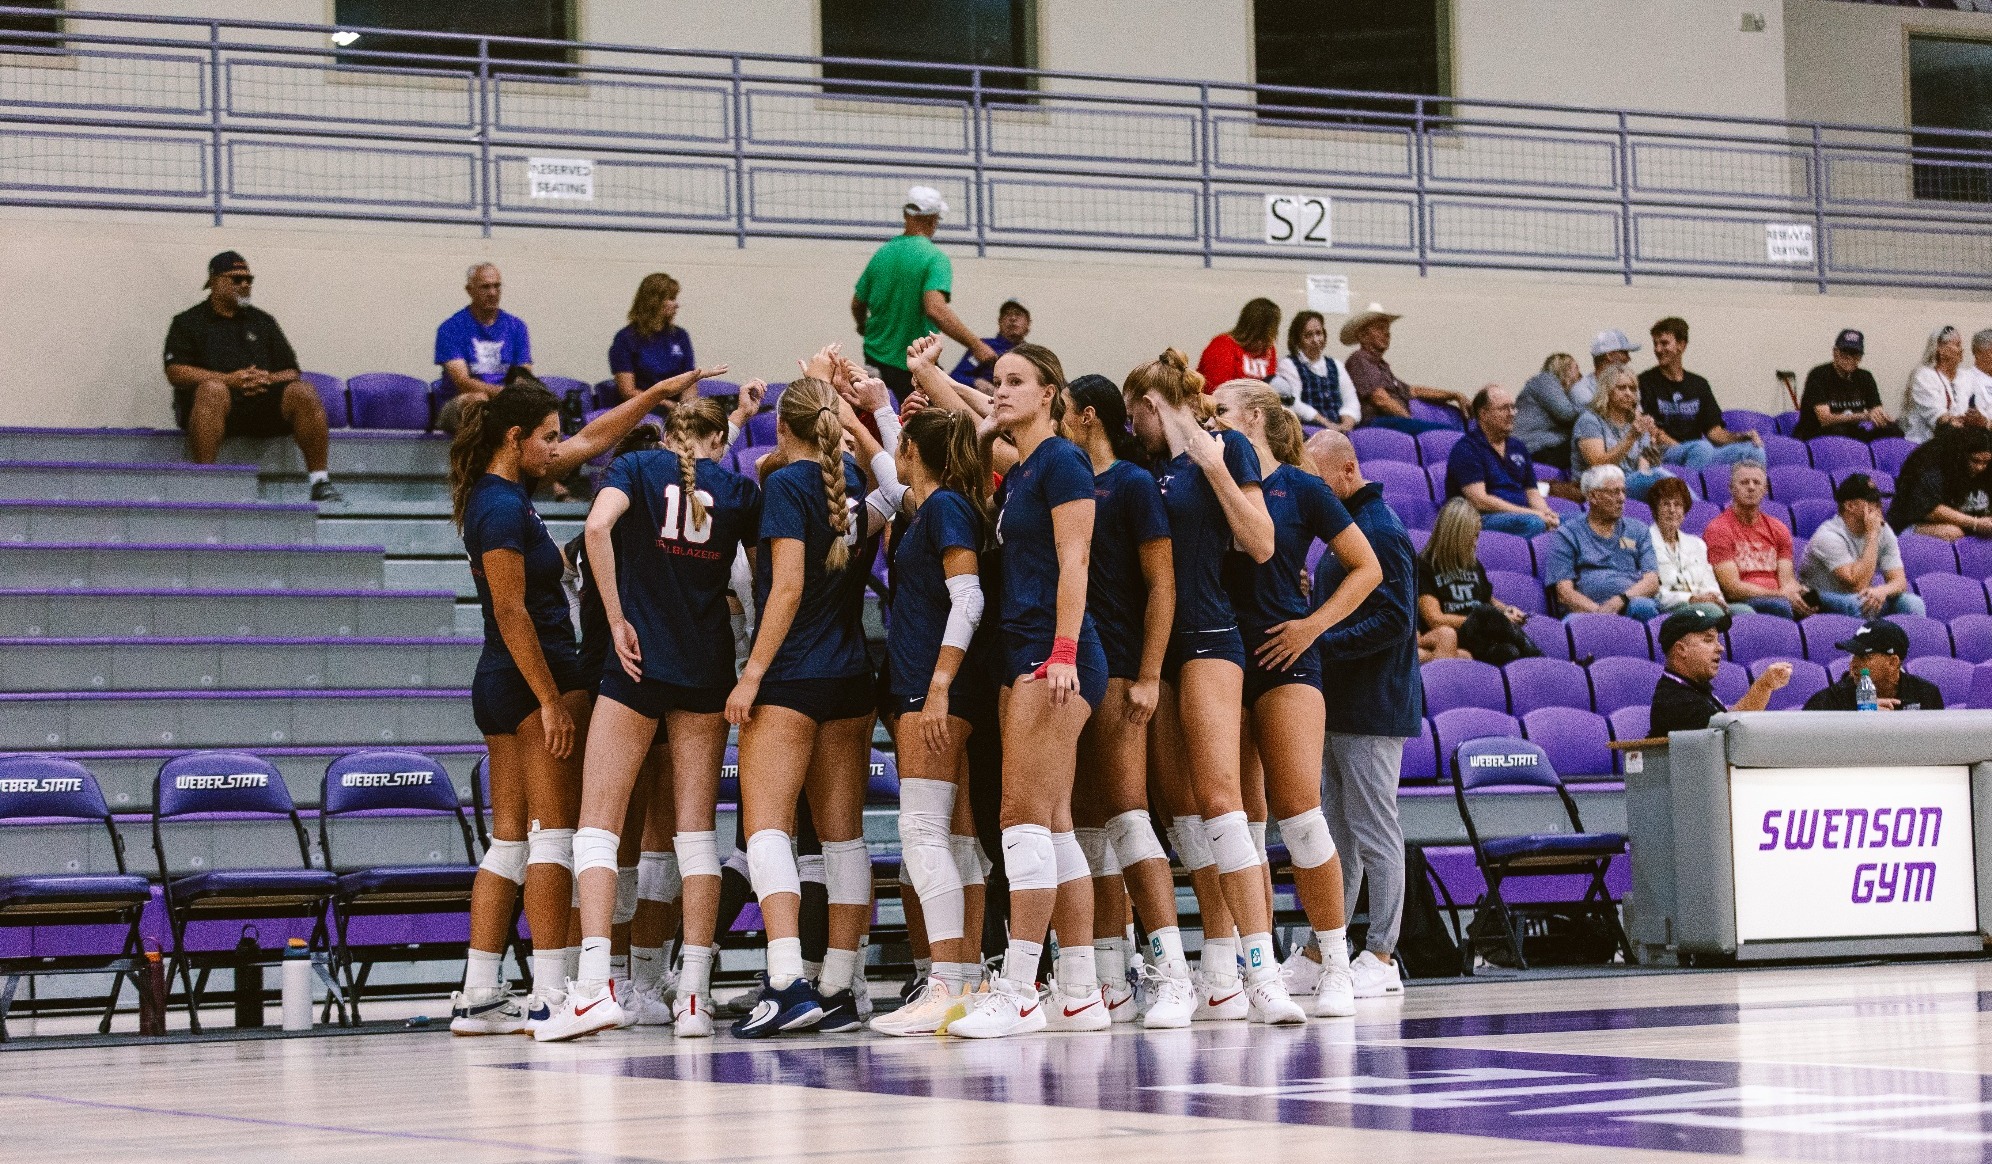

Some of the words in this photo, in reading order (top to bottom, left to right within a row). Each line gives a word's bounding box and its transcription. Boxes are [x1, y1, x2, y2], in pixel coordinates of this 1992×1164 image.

[537, 181, 588, 195] SEATING
[1271, 198, 1327, 242] S2
[661, 484, 715, 544] 16
[655, 538, 721, 560] TRLBLAZERS
[1449, 583, 1475, 601] UT
[1469, 754, 1505, 768] WEBER
[1506, 753, 1538, 767] STATE
[0, 778, 40, 793] EBER
[41, 778, 83, 792] STATE
[176, 775, 224, 789] WEBER
[226, 774, 269, 788] STATE
[341, 773, 391, 787] WEBER
[393, 771, 434, 786] STATE
[1759, 806, 1943, 851] SWENSON
[1851, 861, 1937, 904] GYM
